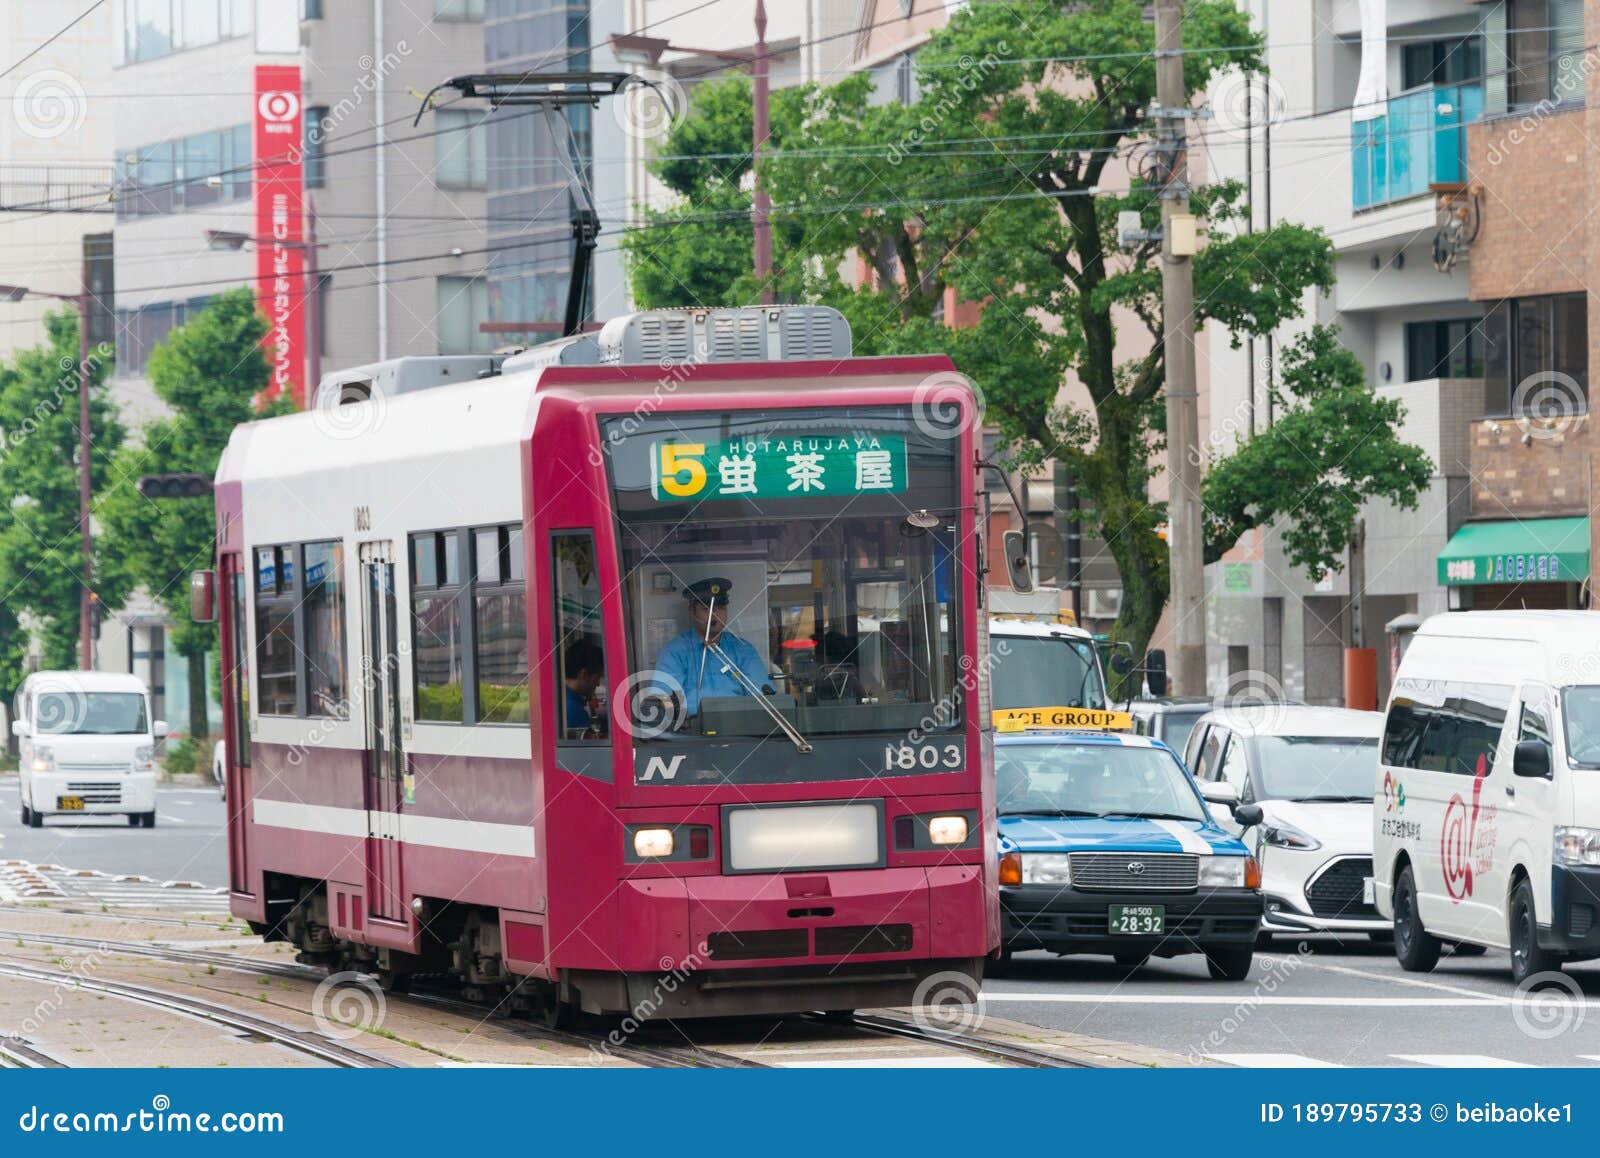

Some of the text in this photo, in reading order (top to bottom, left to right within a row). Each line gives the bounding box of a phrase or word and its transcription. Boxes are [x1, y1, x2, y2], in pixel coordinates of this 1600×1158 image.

[729, 438, 881, 454] HOTARUJAYA
[660, 443, 707, 497] 5
[718, 450, 894, 495] 蛍茶屋
[1051, 712, 1116, 726] GROUP
[885, 744, 961, 770] 1803
[1120, 916, 1161, 932] 28-92
